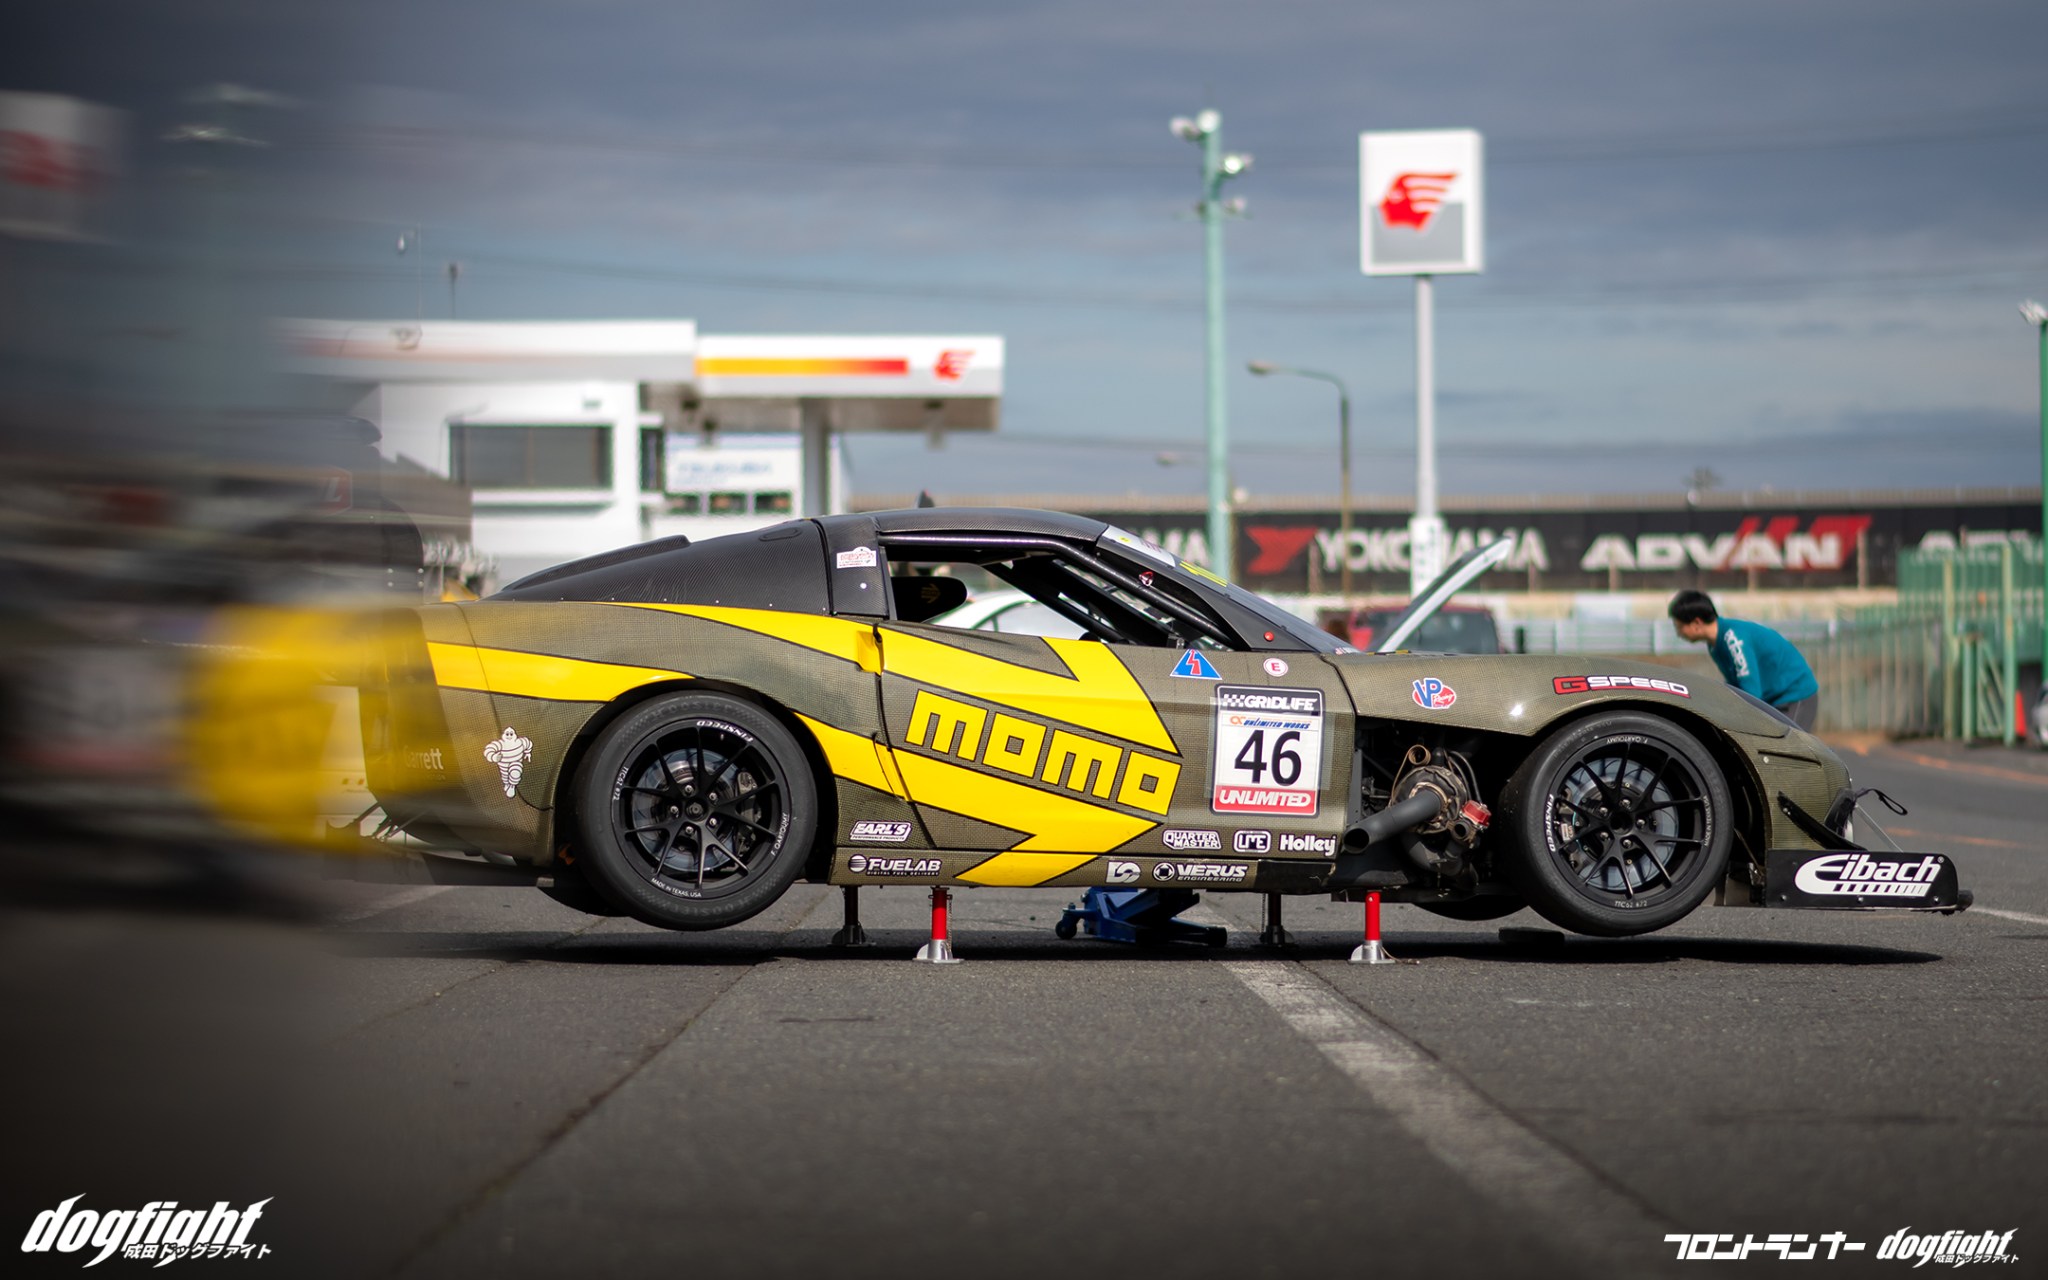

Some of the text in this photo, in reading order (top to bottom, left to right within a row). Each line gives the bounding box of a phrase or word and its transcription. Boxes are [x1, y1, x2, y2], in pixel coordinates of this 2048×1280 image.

[1580, 532, 1842, 570] ADVAN
[1413, 679, 1442, 707] VP
[1553, 675, 1690, 695] GSPEED
[1243, 694, 1318, 711] GRIDLIFE
[696, 719, 754, 743] FINSPEED
[1234, 729, 1302, 787] 46
[1219, 789, 1312, 807] UNLIMITED
[853, 823, 907, 835] EARL'S
[1544, 793, 1556, 852] FINSPEED
[1165, 831, 1217, 843] QUARTER
[1174, 839, 1219, 848] MASTER
[1279, 834, 1337, 856] Holley
[1176, 864, 1249, 878] VERUS
[1795, 853, 1941, 897] Eibach
